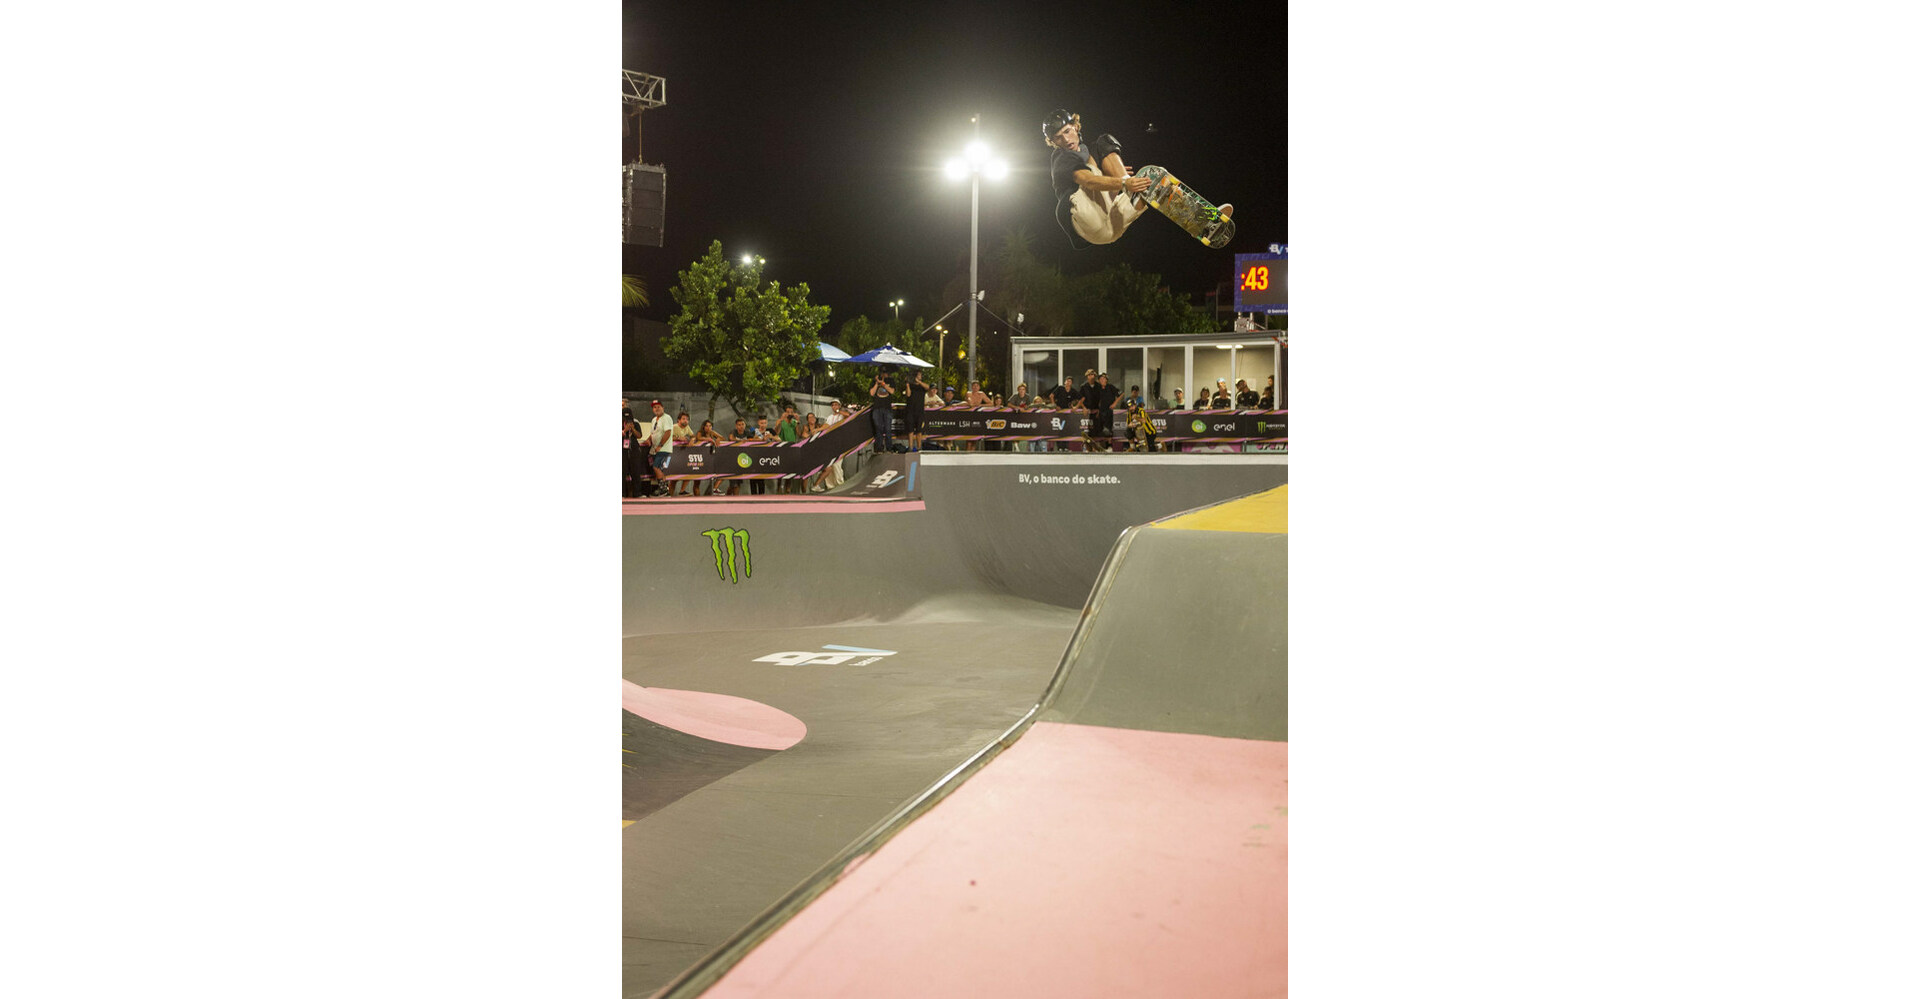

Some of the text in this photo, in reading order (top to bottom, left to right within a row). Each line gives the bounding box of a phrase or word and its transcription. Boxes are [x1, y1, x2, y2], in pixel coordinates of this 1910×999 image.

[1152, 418, 1167, 426] STU
[1213, 422, 1235, 431] enel
[688, 454, 703, 462] STU
[759, 456, 780, 466] enel
[1019, 473, 1032, 485] BV,
[1041, 473, 1070, 484] banco
[1072, 474, 1085, 484] do
[1087, 474, 1121, 484] skate.
